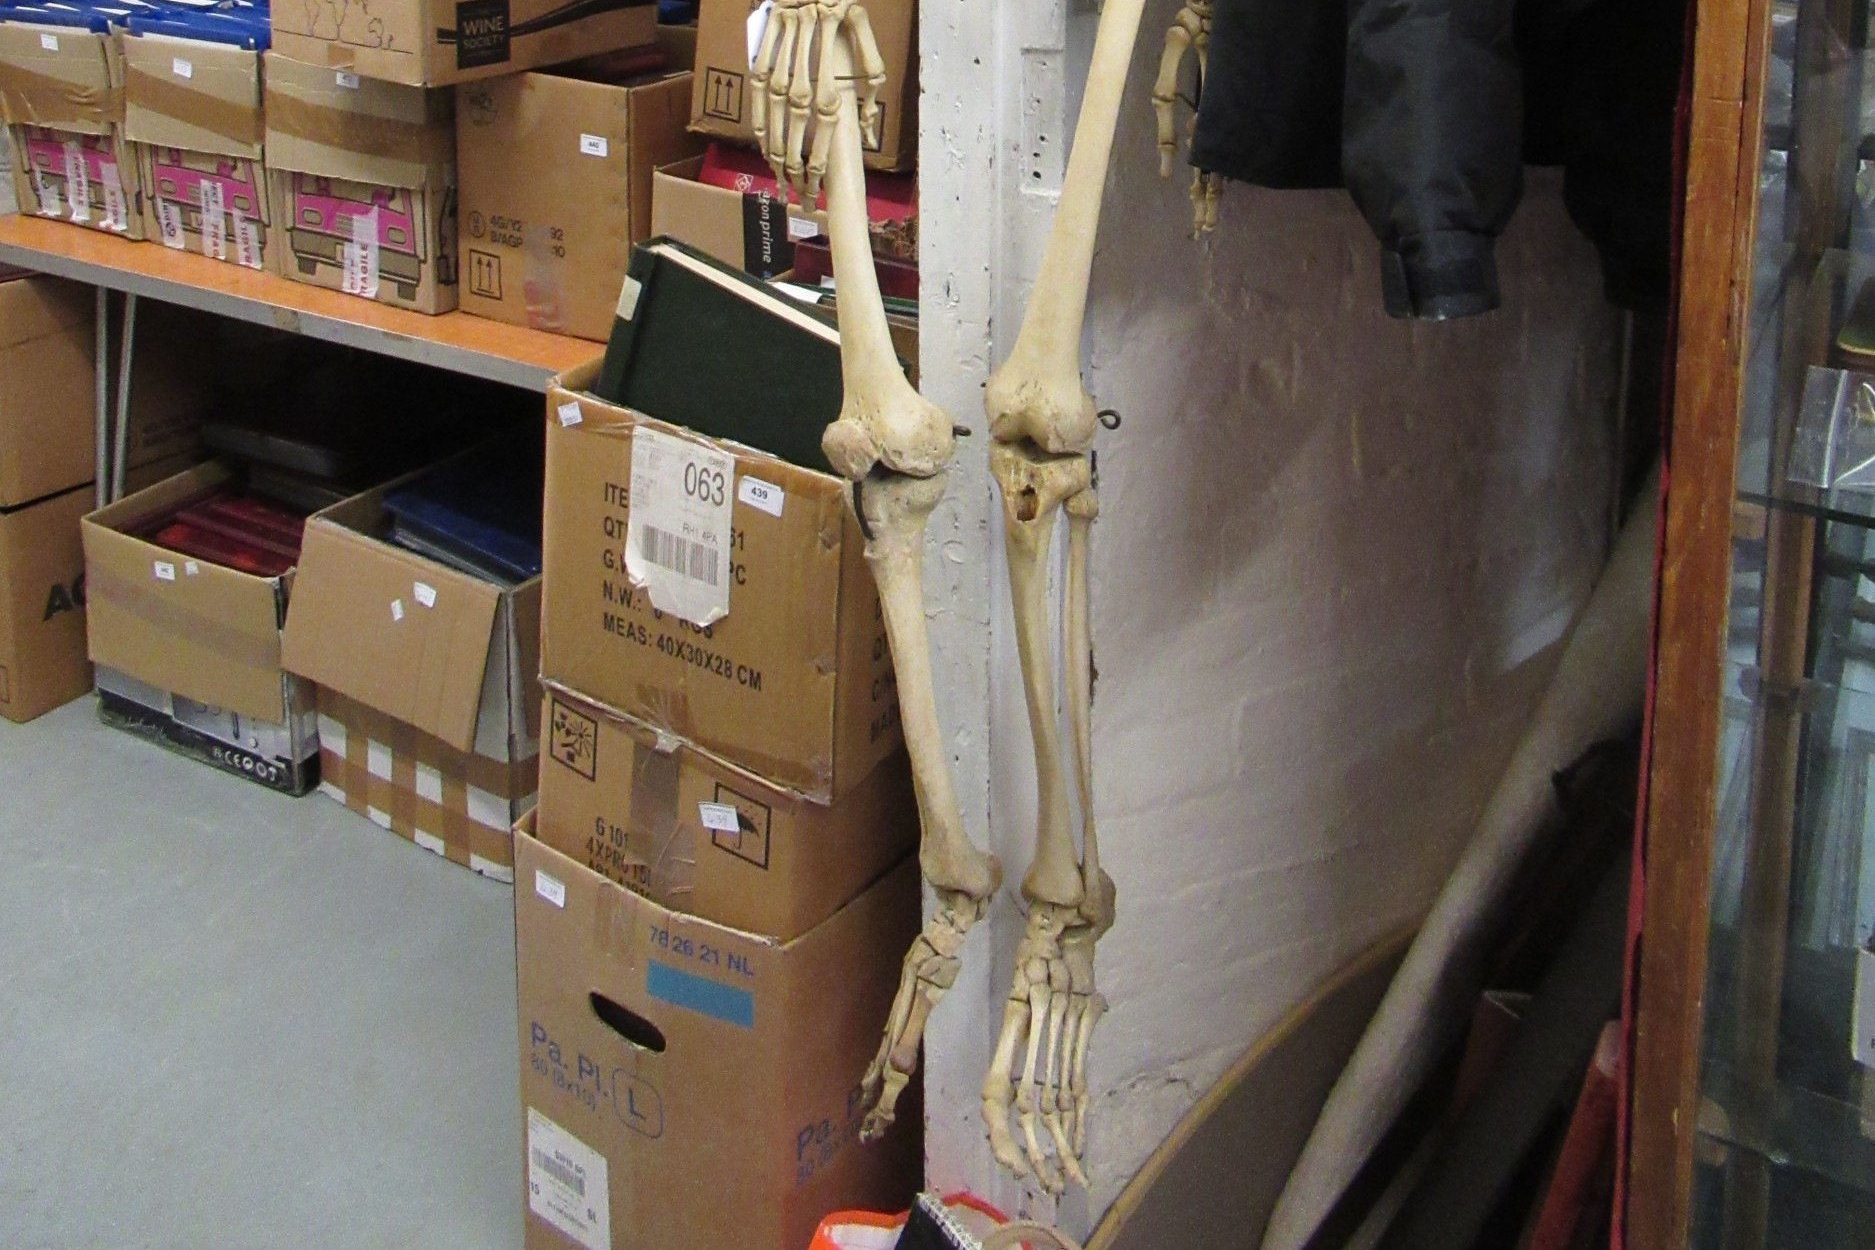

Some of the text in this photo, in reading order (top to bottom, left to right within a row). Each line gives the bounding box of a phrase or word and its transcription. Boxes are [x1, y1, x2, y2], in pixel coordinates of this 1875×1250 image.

[463, 15, 504, 36] WINE
[463, 35, 504, 49] SOCIETY
[759, 220, 774, 263] prime
[604, 481, 629, 509] ITE
[684, 461, 725, 507] 063
[751, 486, 768, 500] 439
[603, 580, 642, 612] N.W.:
[603, 612, 762, 692] MEAS: 40X30X28 CM
[650, 925, 754, 977] 78 26 21 NL
[531, 1021, 568, 1070] Pa.
[627, 1086, 646, 1121] L
